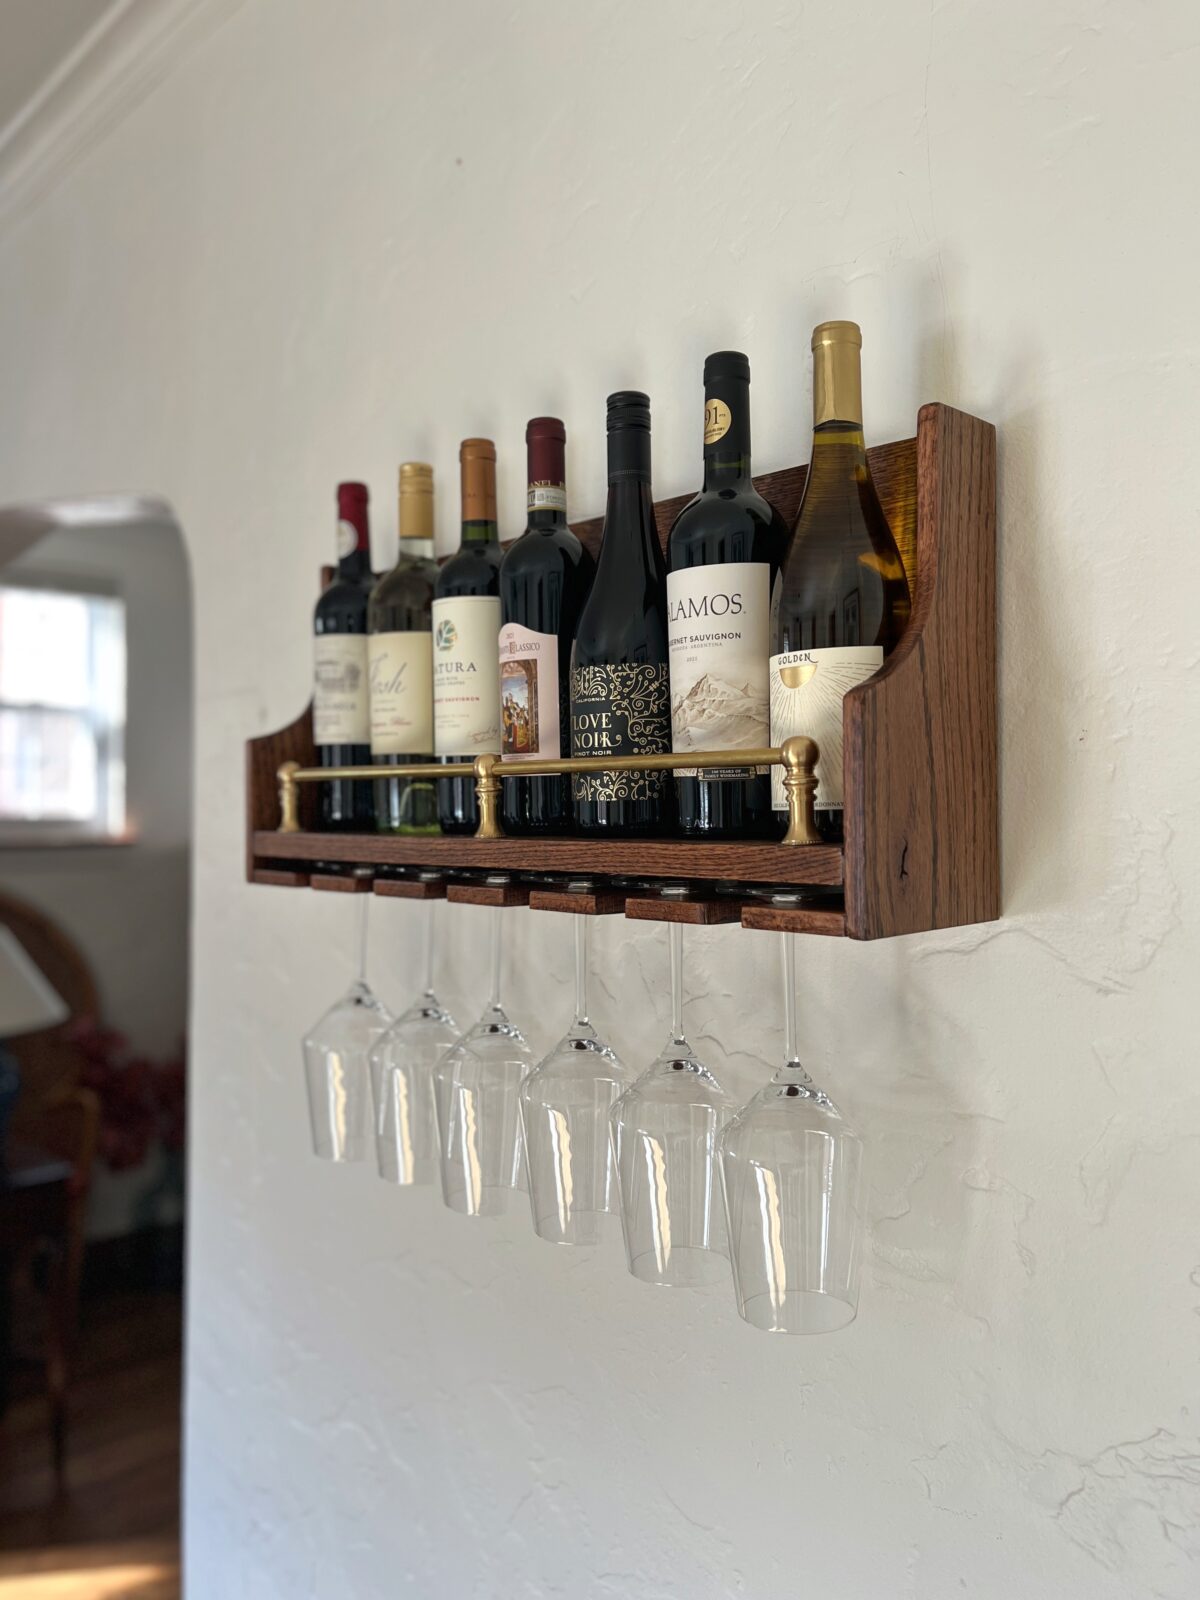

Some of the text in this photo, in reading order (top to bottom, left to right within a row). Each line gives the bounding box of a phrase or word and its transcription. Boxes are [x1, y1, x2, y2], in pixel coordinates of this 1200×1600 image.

[689, 632, 742, 643] SAUVIGNON
[778, 652, 819, 666] GOLDEN
[575, 696, 606, 704] CALIFORNIA
[571, 712, 612, 731] LOVE
[573, 731, 622, 749] NOIR
